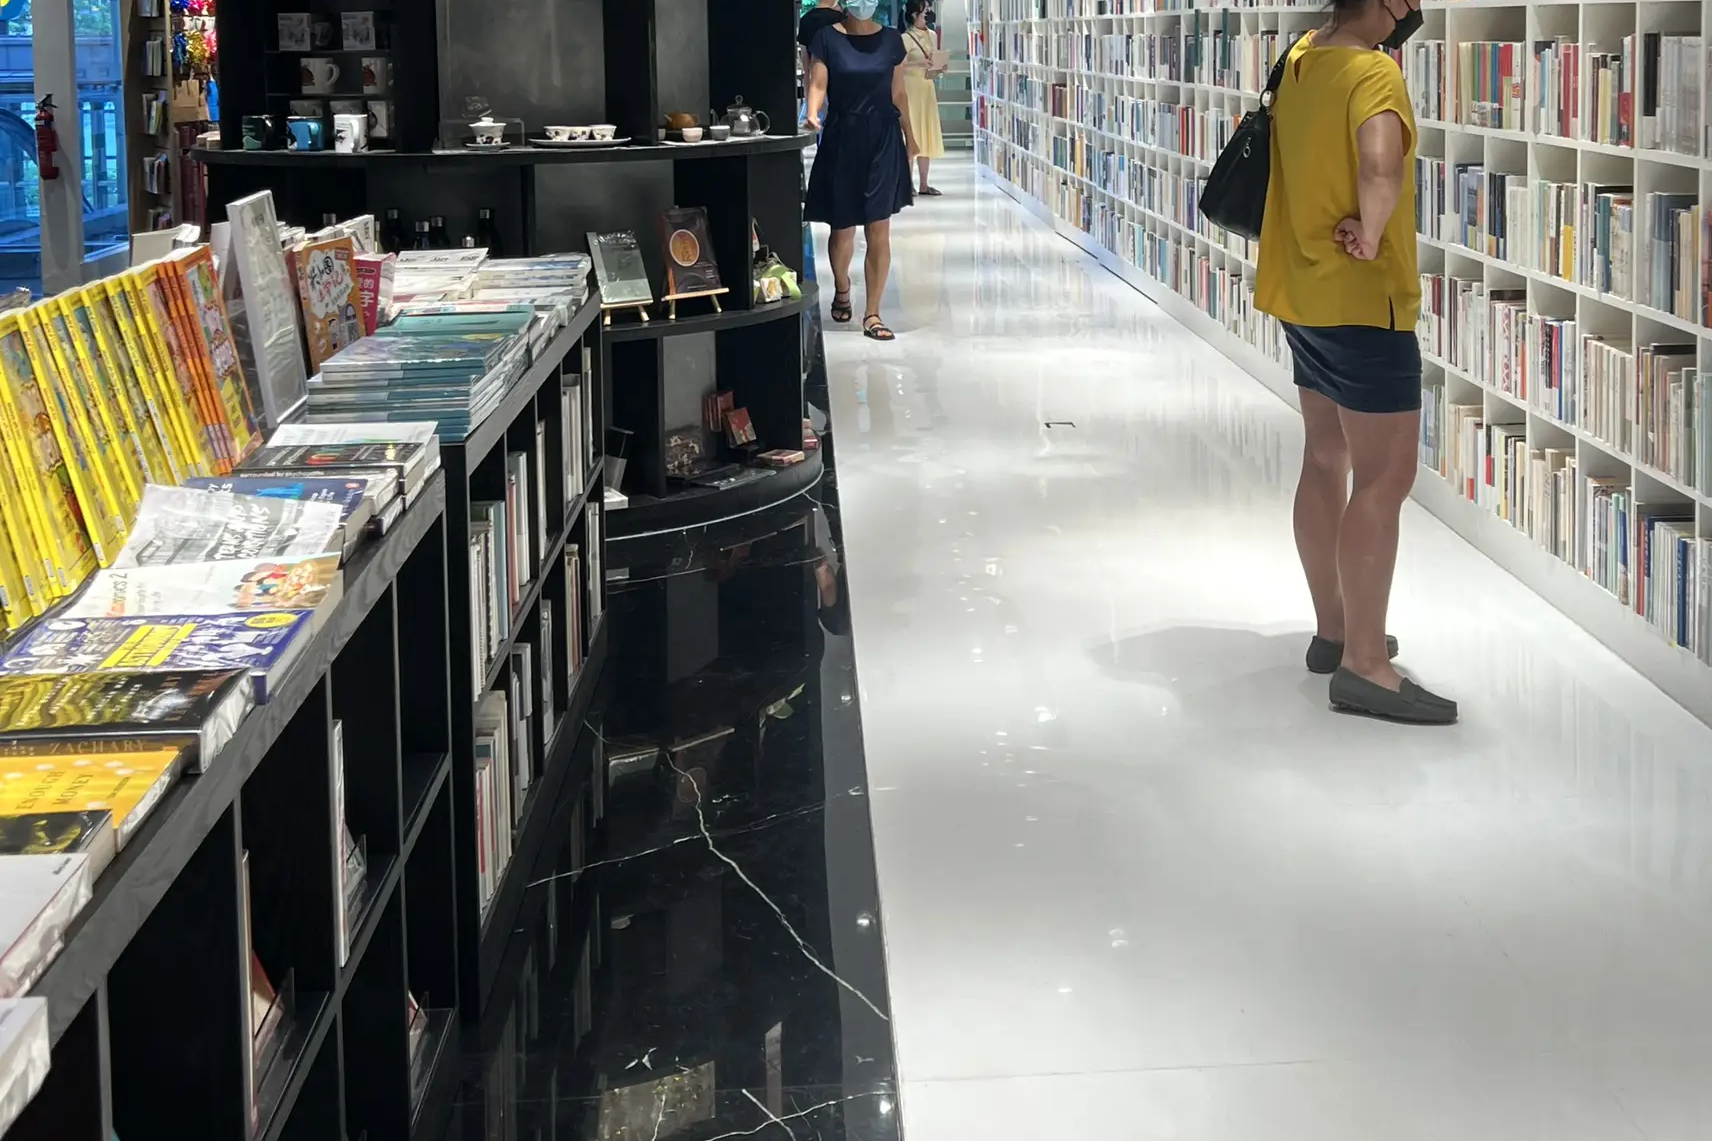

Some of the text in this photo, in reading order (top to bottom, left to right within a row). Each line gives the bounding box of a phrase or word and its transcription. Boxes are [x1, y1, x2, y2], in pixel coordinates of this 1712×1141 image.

[49, 739, 146, 754] ZACHARY
[15, 770, 64, 810] ENOUGH
[53, 772, 94, 807] MONEY
